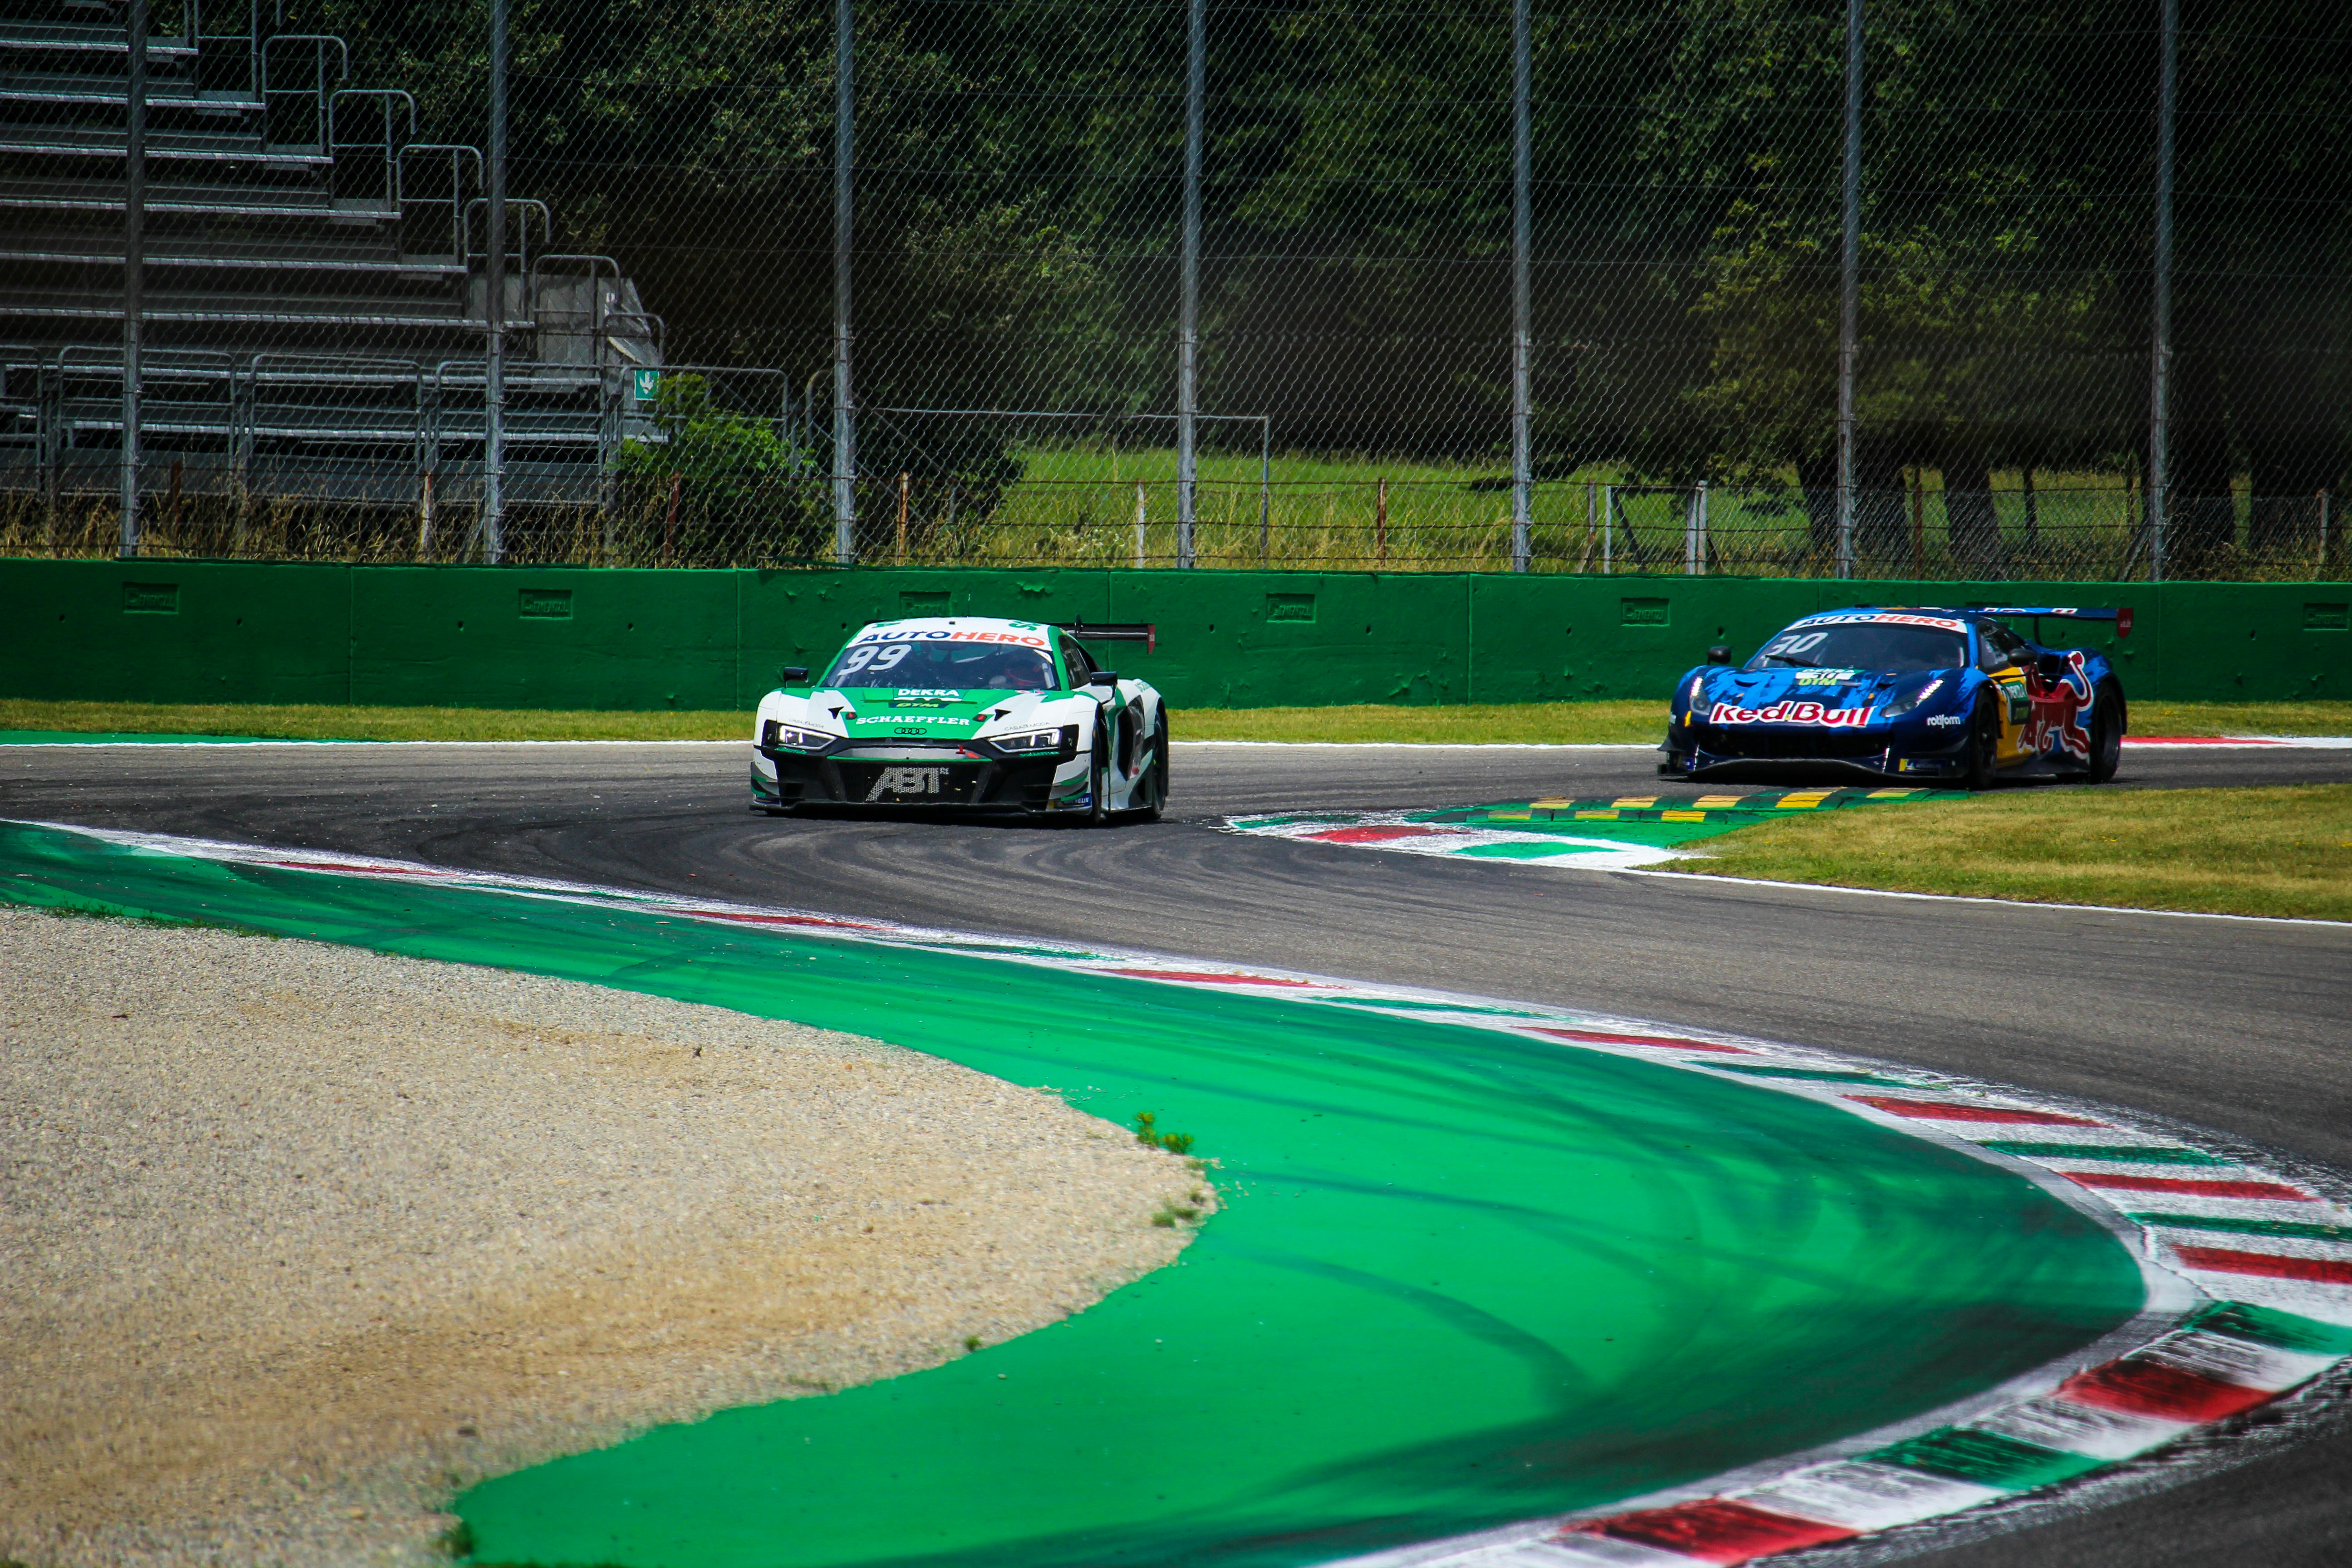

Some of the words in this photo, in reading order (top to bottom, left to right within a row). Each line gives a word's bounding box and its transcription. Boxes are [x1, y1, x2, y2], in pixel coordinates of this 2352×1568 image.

[1799, 615, 1957, 627] AUTOHERO
[857, 631, 1045, 646] AUTOHERO
[1767, 632, 1828, 655] 30
[837, 645, 911, 676] 99
[856, 715, 970, 725] SCHAEFFLER
[1927, 714, 1960, 728] rotiform
[866, 767, 949, 801] ABT
